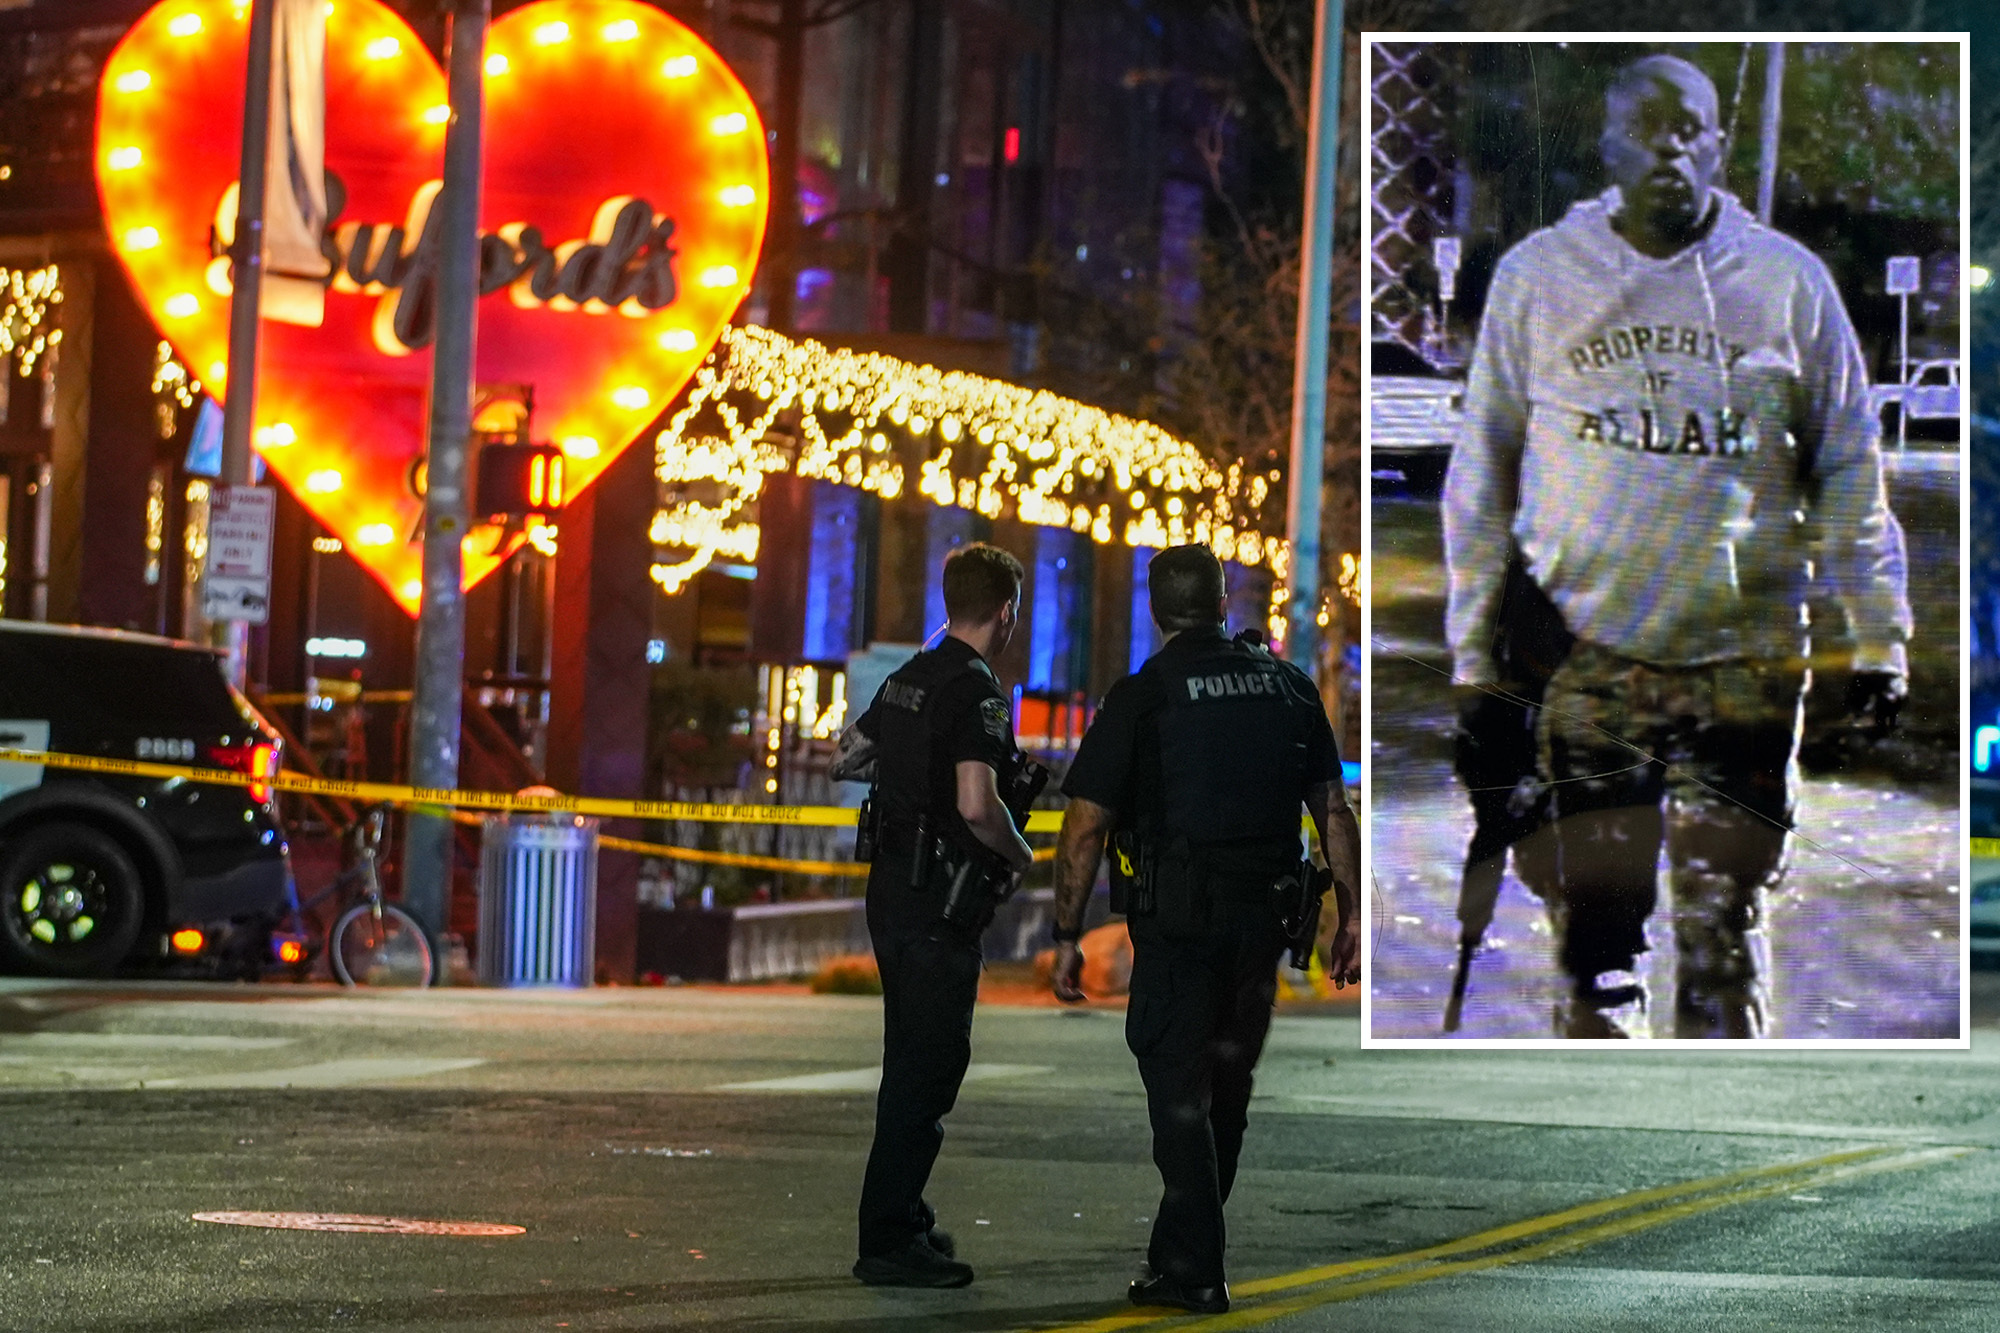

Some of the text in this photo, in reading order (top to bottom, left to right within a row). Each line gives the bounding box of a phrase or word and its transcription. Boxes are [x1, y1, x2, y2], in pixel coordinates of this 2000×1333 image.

[205, 168, 678, 353] uford's
[1567, 325, 1748, 374] PROPERTY
[1186, 671, 1278, 701] POLICE
